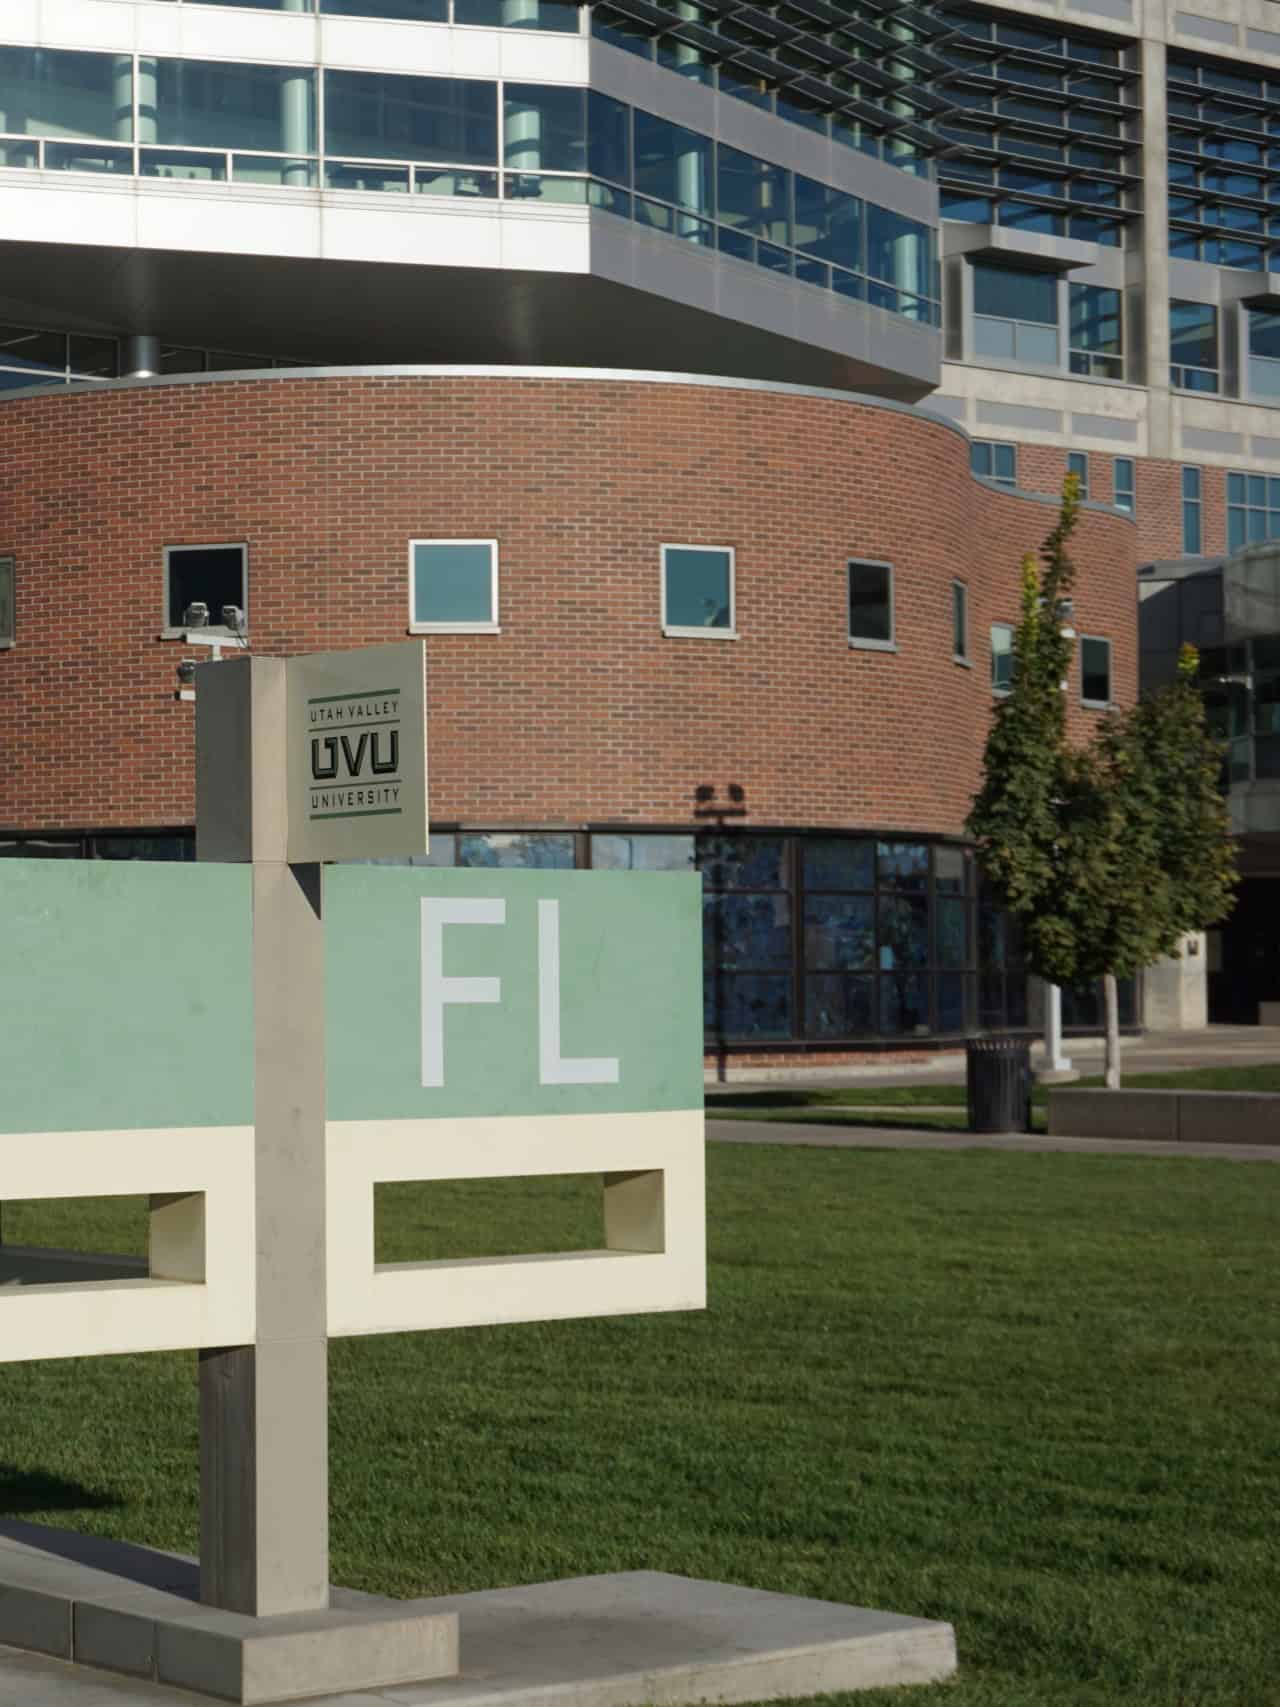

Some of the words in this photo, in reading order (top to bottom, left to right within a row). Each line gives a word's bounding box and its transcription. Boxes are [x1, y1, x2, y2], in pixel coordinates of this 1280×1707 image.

[310, 703, 343, 722] UTAH
[348, 701, 399, 718] VALLEY
[311, 730, 399, 780] UVU
[311, 788, 400, 809] UNIVERSITY
[420, 896, 620, 1088] FL
